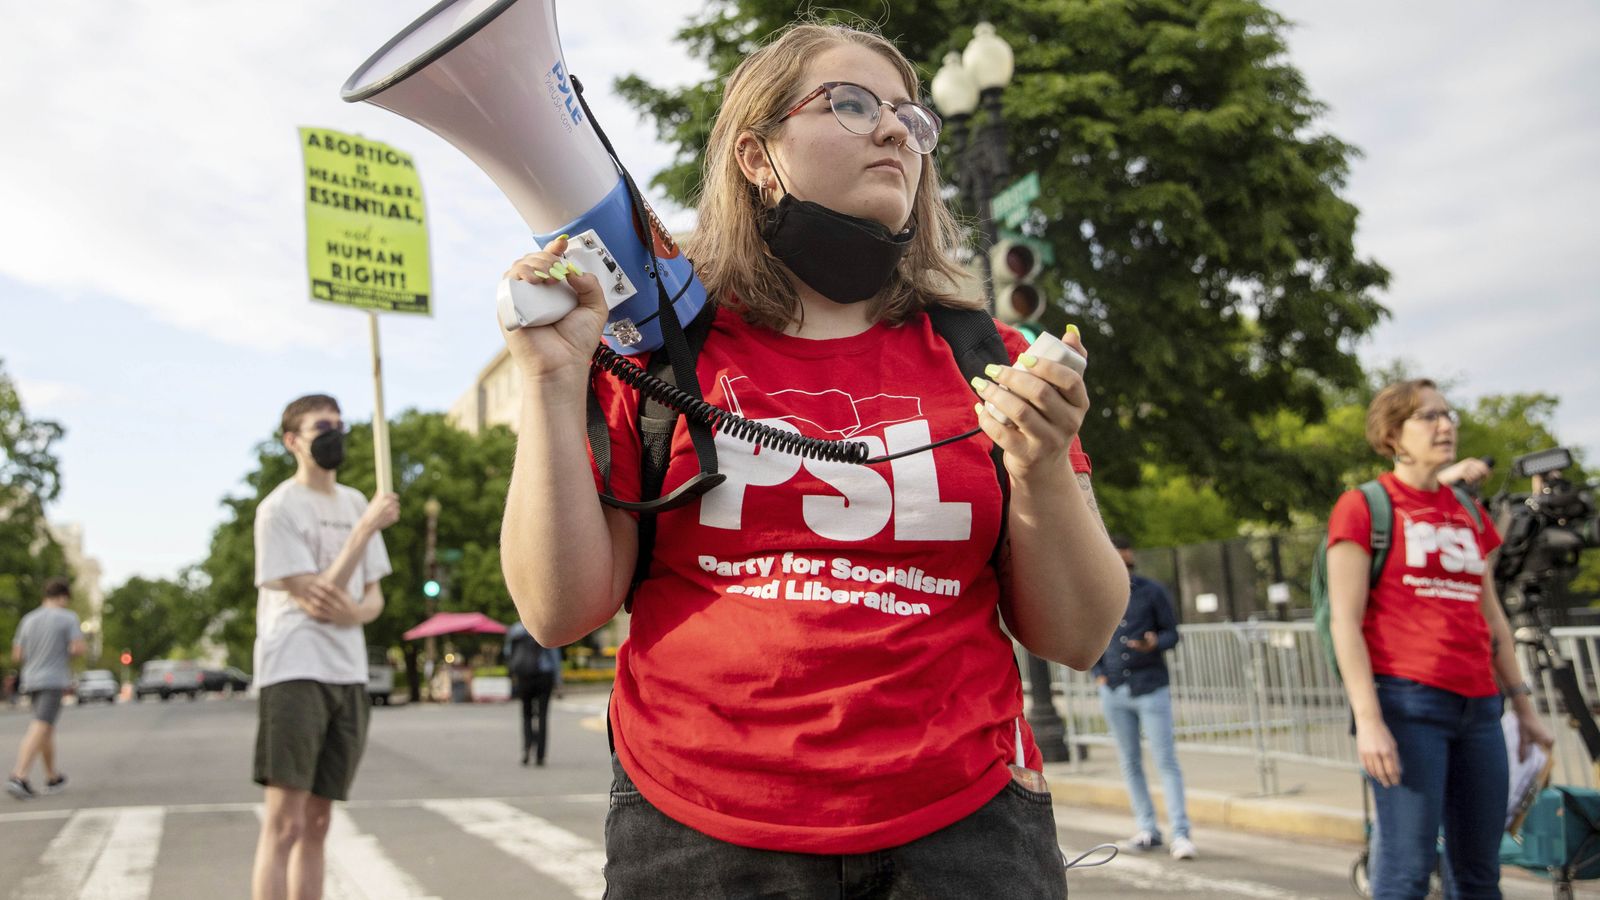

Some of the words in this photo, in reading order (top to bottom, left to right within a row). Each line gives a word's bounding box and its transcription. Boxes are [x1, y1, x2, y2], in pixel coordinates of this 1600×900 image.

[552, 60, 582, 126] PYLE
[307, 133, 414, 169] ABORTION
[356, 164, 369, 176] IS
[326, 240, 404, 266] HUMAN
[331, 262, 407, 289] RIGHT!
[699, 418, 972, 541] PSL
[1403, 519, 1486, 576] PSL
[698, 555, 775, 578] Party
[781, 552, 825, 576] for
[831, 558, 961, 597] Socialism
[726, 579, 780, 600] and
[785, 580, 931, 616] Liberation
